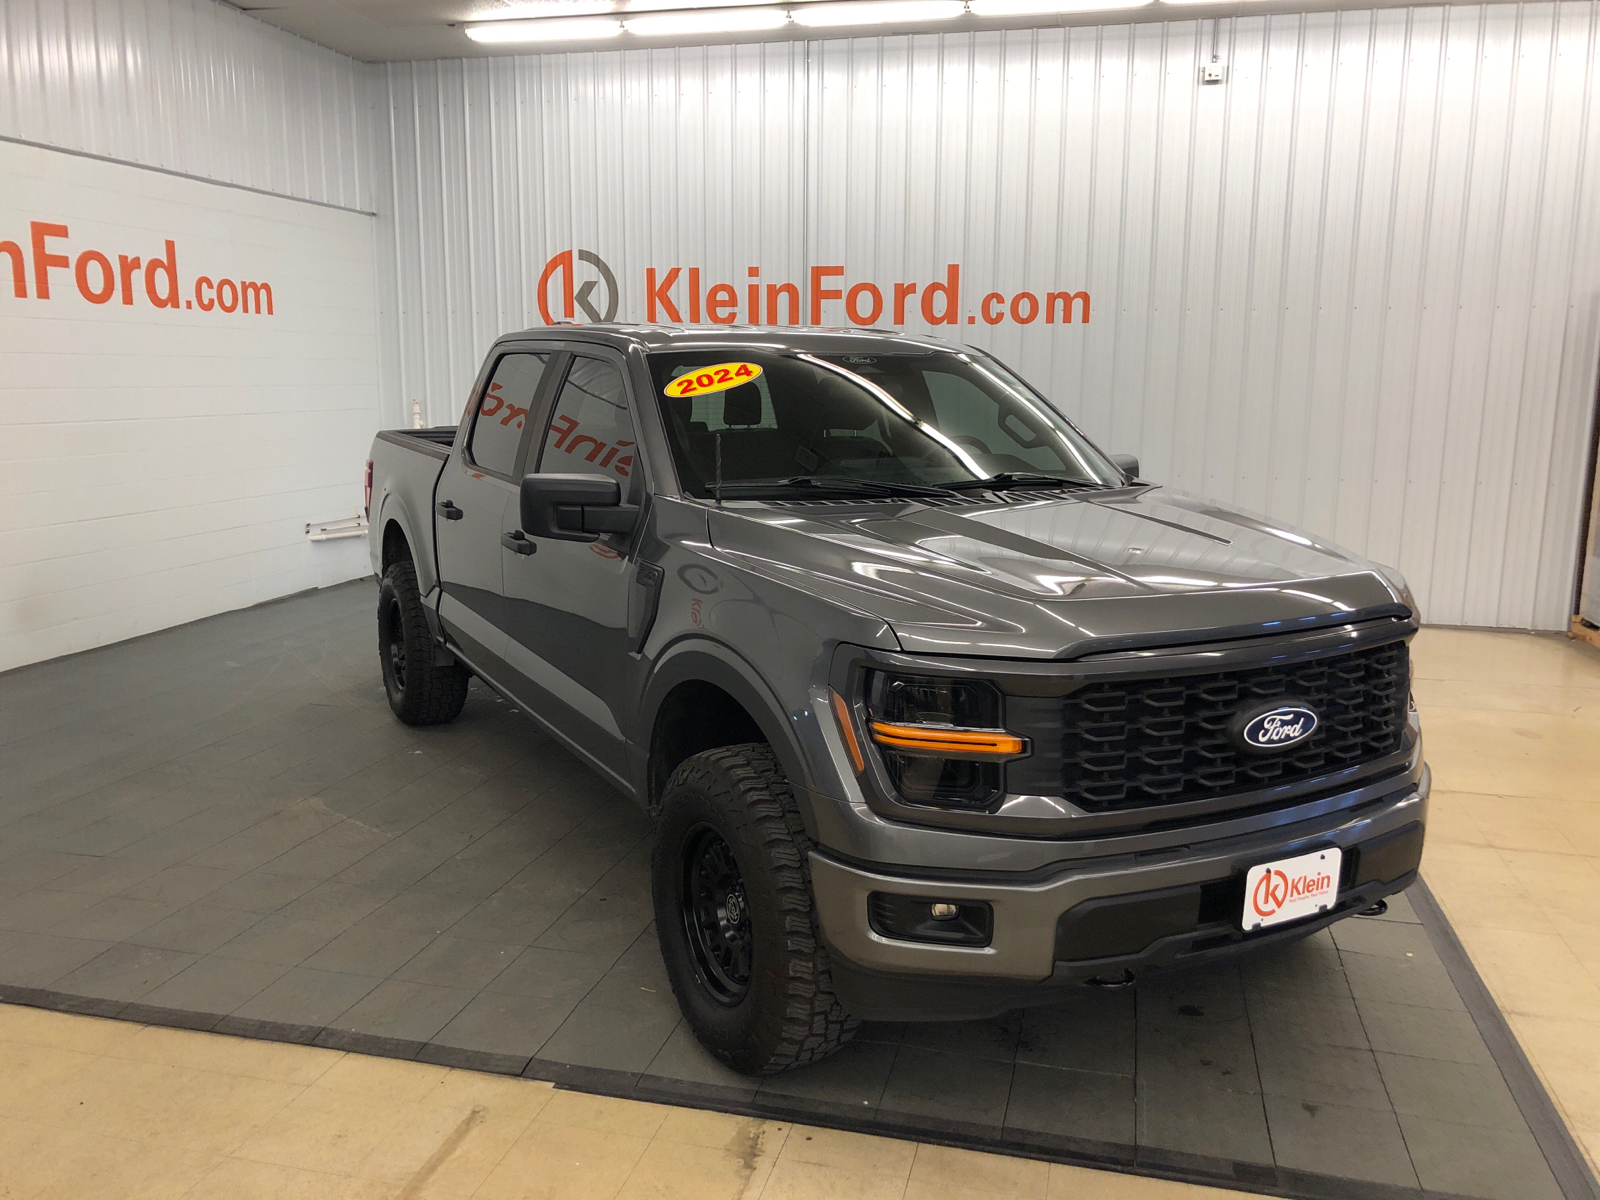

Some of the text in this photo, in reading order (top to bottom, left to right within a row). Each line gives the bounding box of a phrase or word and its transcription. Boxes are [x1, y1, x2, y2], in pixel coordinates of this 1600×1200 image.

[646, 264, 1091, 325] KleinFord.com
[677, 364, 754, 395] 2024
[1258, 713, 1304, 743] Ford
[1290, 871, 1331, 898] Klein
